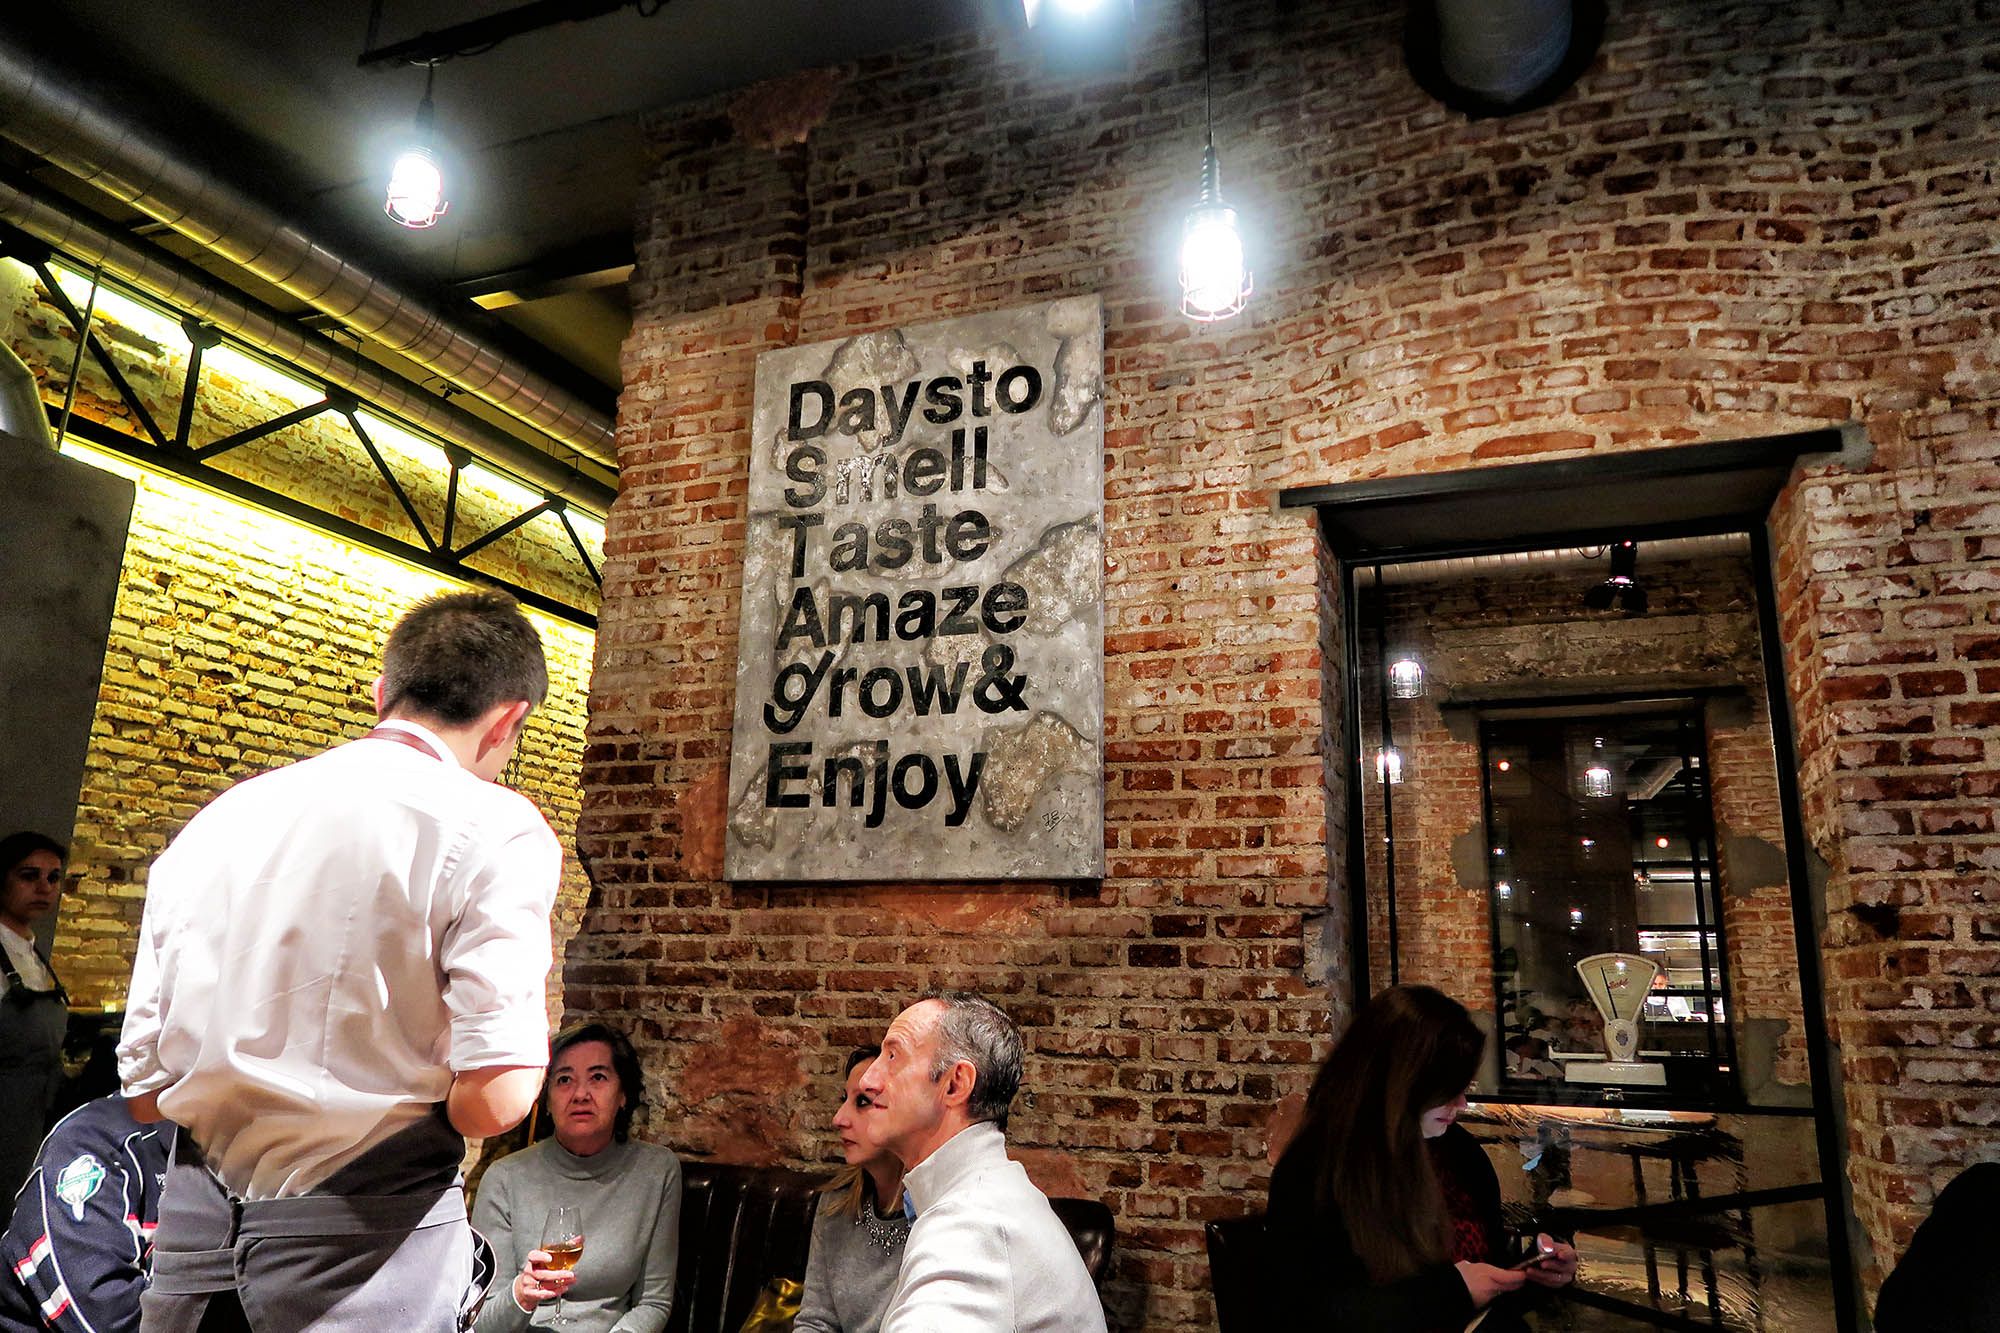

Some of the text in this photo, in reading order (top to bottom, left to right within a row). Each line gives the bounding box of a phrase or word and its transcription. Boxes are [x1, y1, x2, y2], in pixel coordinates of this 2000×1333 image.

[784, 426, 988, 508] Smell
[779, 503, 990, 580] Taste
[776, 582, 1030, 650] Amaze
[765, 740, 988, 828] Enjoy
